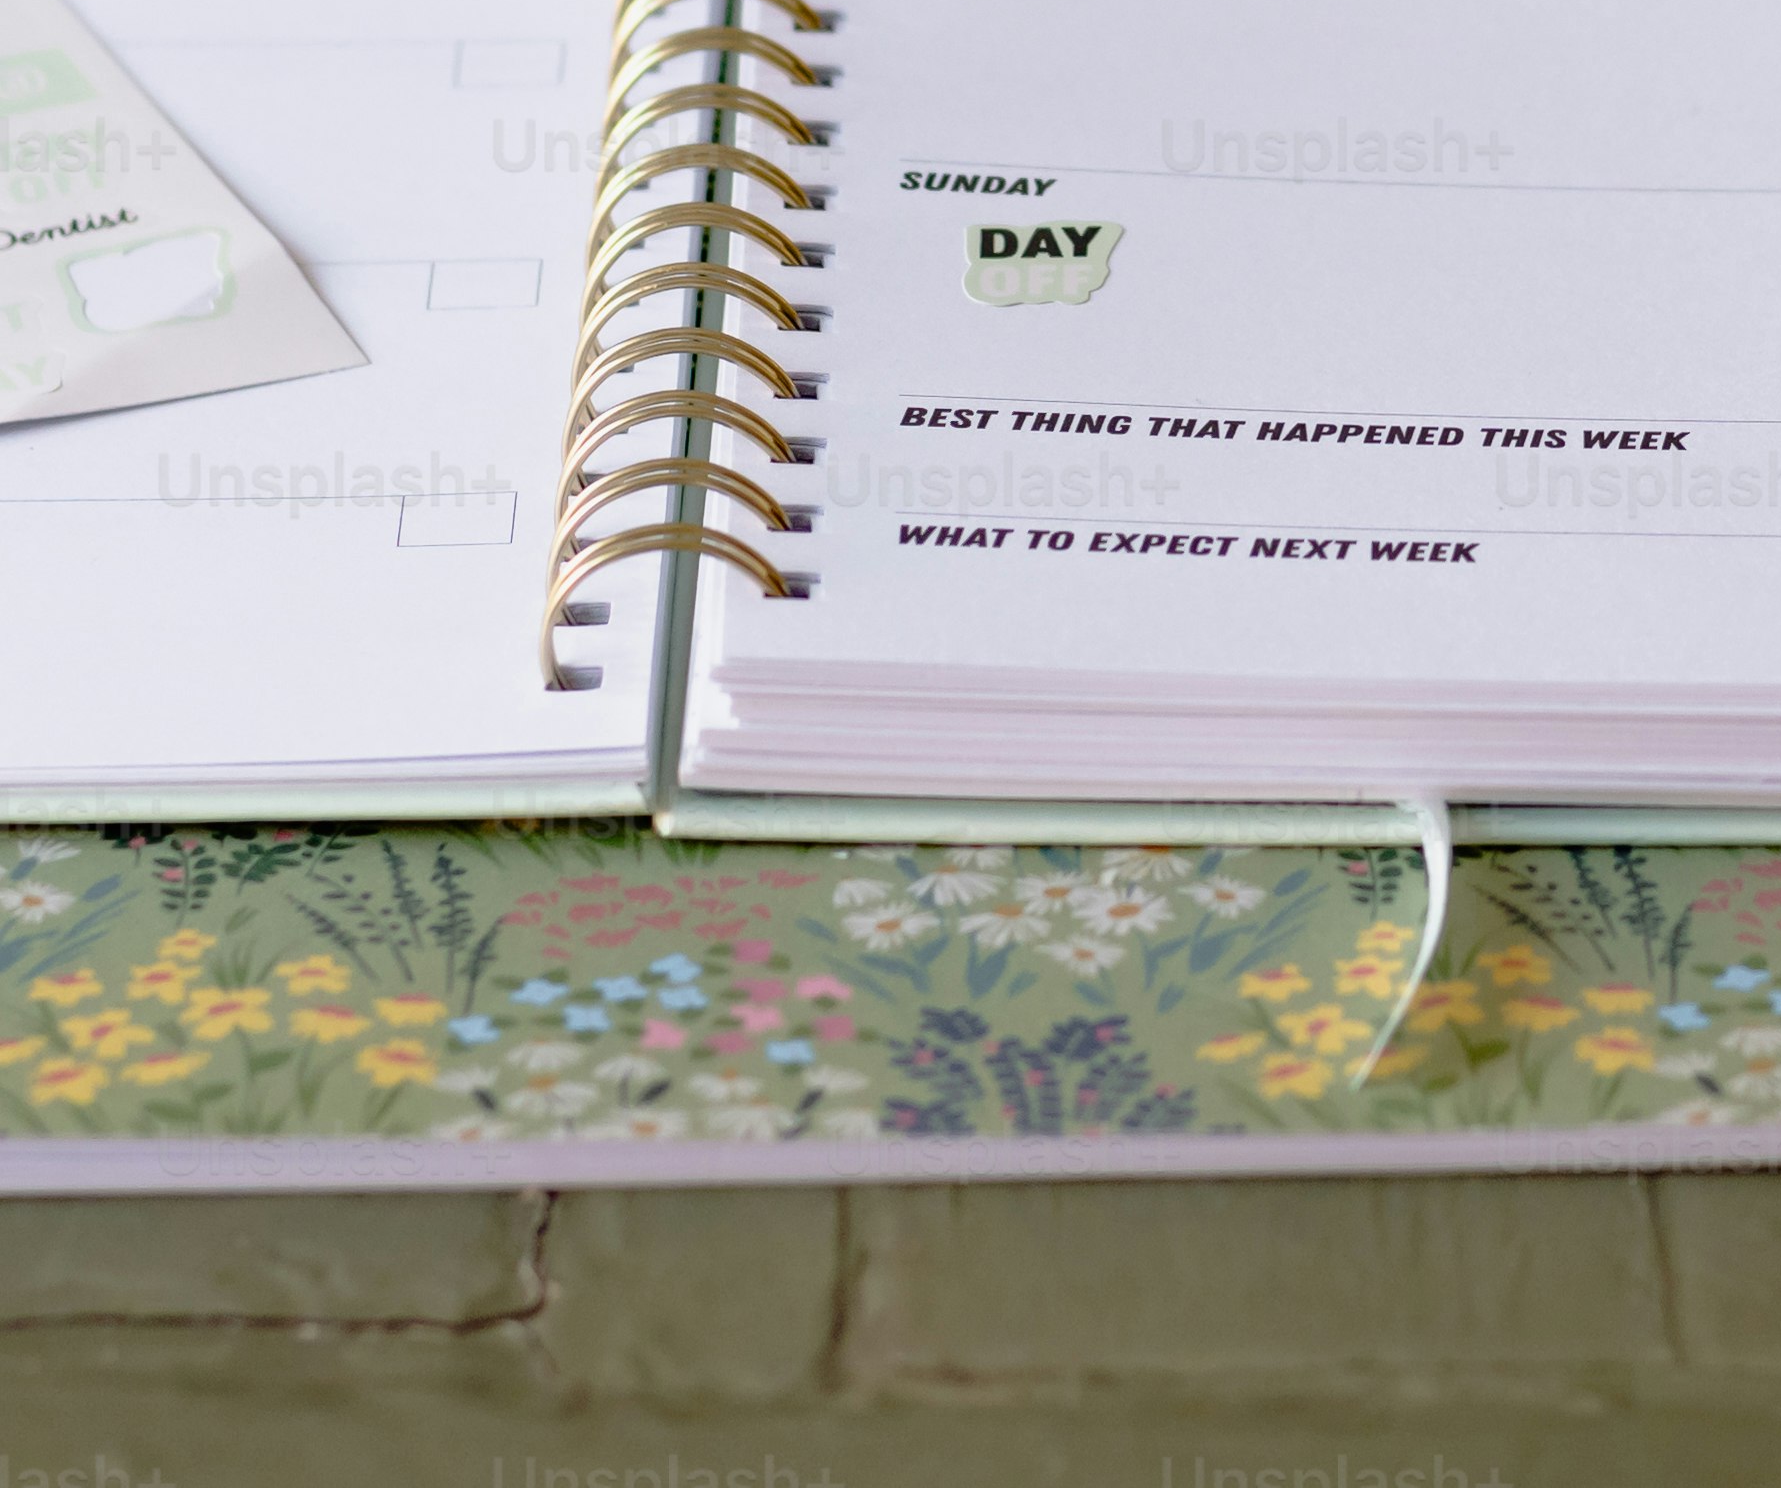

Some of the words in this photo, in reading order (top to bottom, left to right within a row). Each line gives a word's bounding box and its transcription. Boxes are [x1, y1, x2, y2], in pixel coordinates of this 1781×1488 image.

[899, 170, 1058, 197] SUNDAY
[979, 226, 1102, 260] DAY
[979, 263, 1094, 299] OFF
[900, 406, 999, 431] BEST
[1011, 410, 1132, 436] THING
[1148, 416, 1246, 441] THAT
[1256, 421, 1466, 447] HAPPENED
[1480, 427, 1569, 450] THIS
[1583, 429, 1691, 452] WEEK
[898, 524, 1014, 550] WHAT
[1027, 529, 1074, 552] TO
[1088, 532, 1240, 558] EXPECT
[1250, 537, 1359, 561] NEXT
[1370, 540, 1480, 564] WEEK
